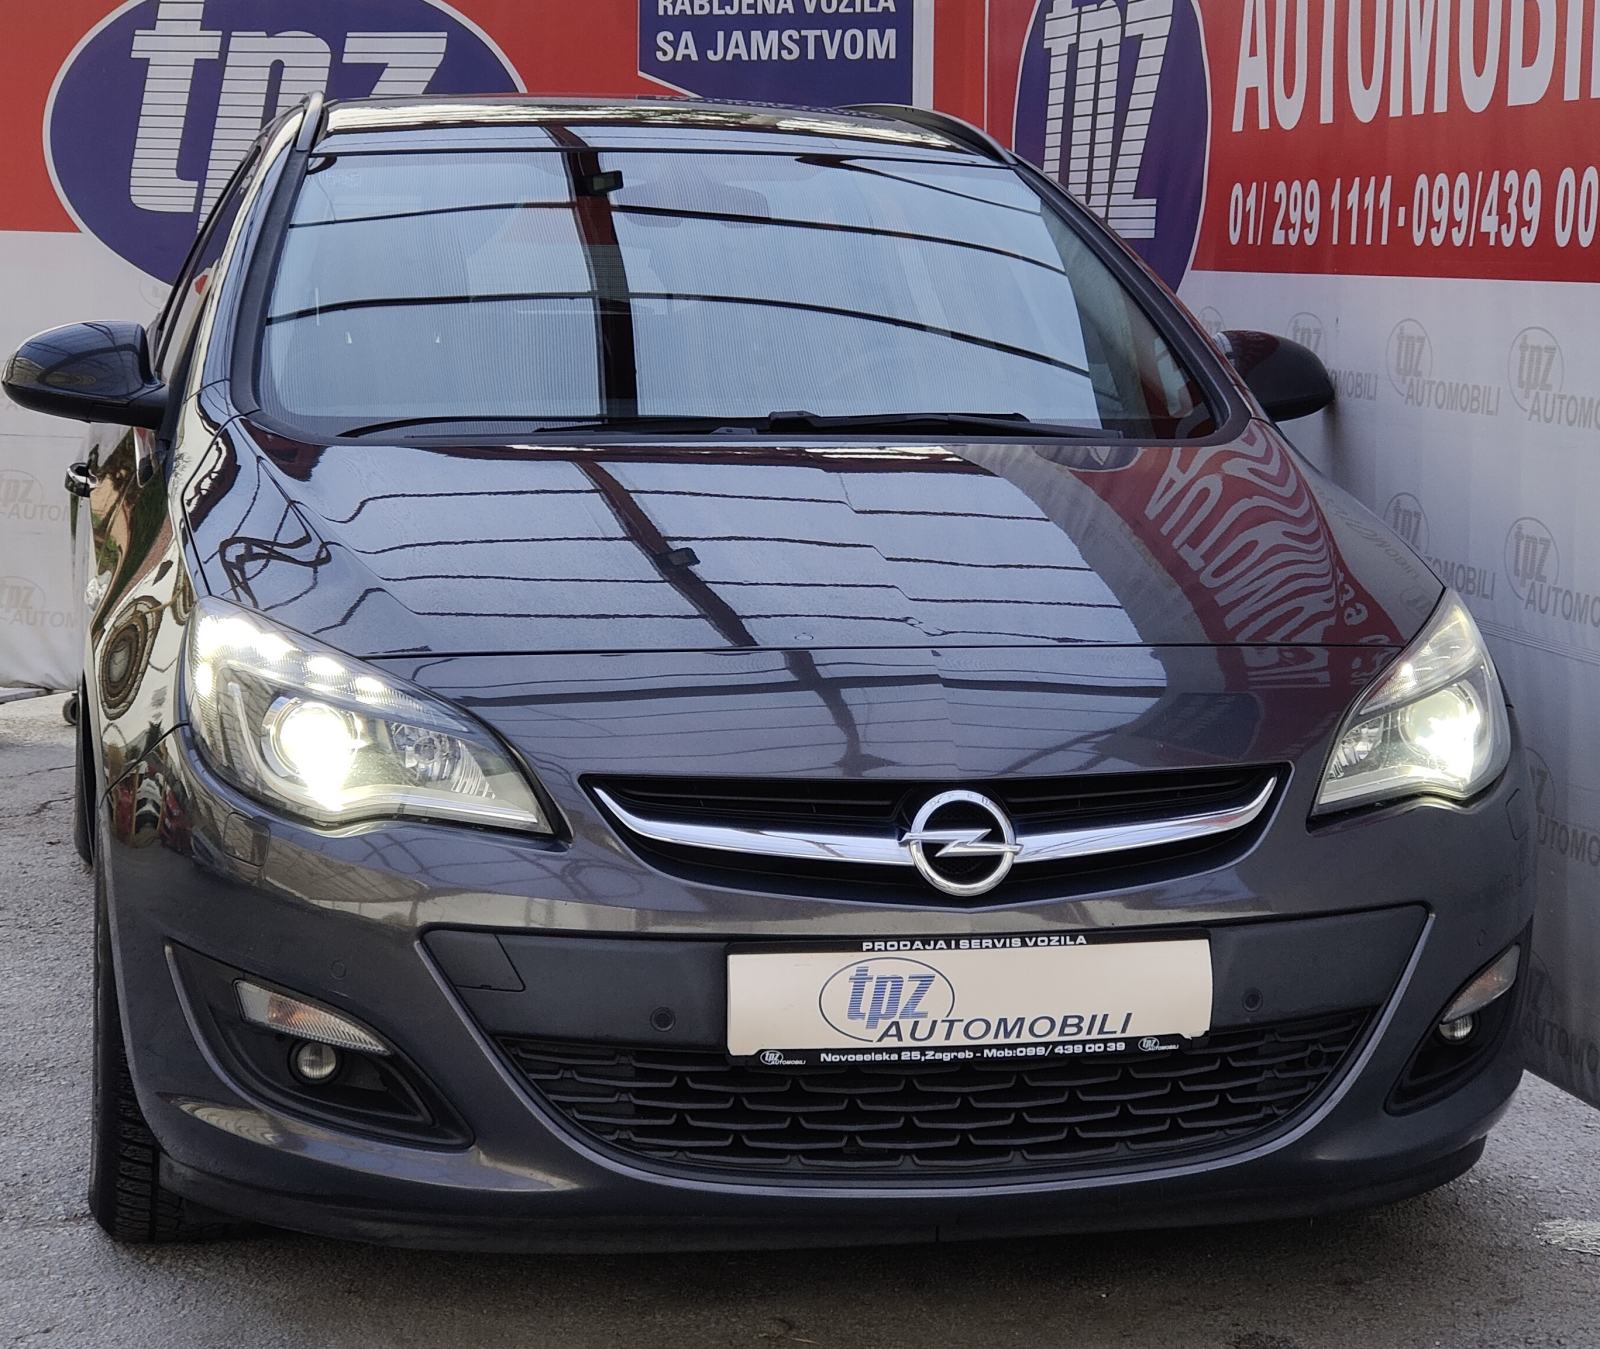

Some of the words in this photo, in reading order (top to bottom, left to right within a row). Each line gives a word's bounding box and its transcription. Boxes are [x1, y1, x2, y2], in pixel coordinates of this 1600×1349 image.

[656, 31, 698, 62] SA
[707, 29, 896, 61] JAMSTVOM
[1272, 179, 1320, 246] 299
[1554, 166, 1600, 247] 00
[1404, 378, 1501, 416] AUTOMOBILI
[1536, 813, 1600, 866] UTOMO
[862, 941, 948, 952] PRODAJA
[959, 938, 1022, 950] SERVIS
[1025, 935, 1088, 947] VOZILA
[847, 966, 936, 1029] tpz
[876, 1012, 1133, 1043] AUTOMOBILI
[820, 1052, 899, 1063] Novoselska
[1055, 1044, 1083, 1055] 439
